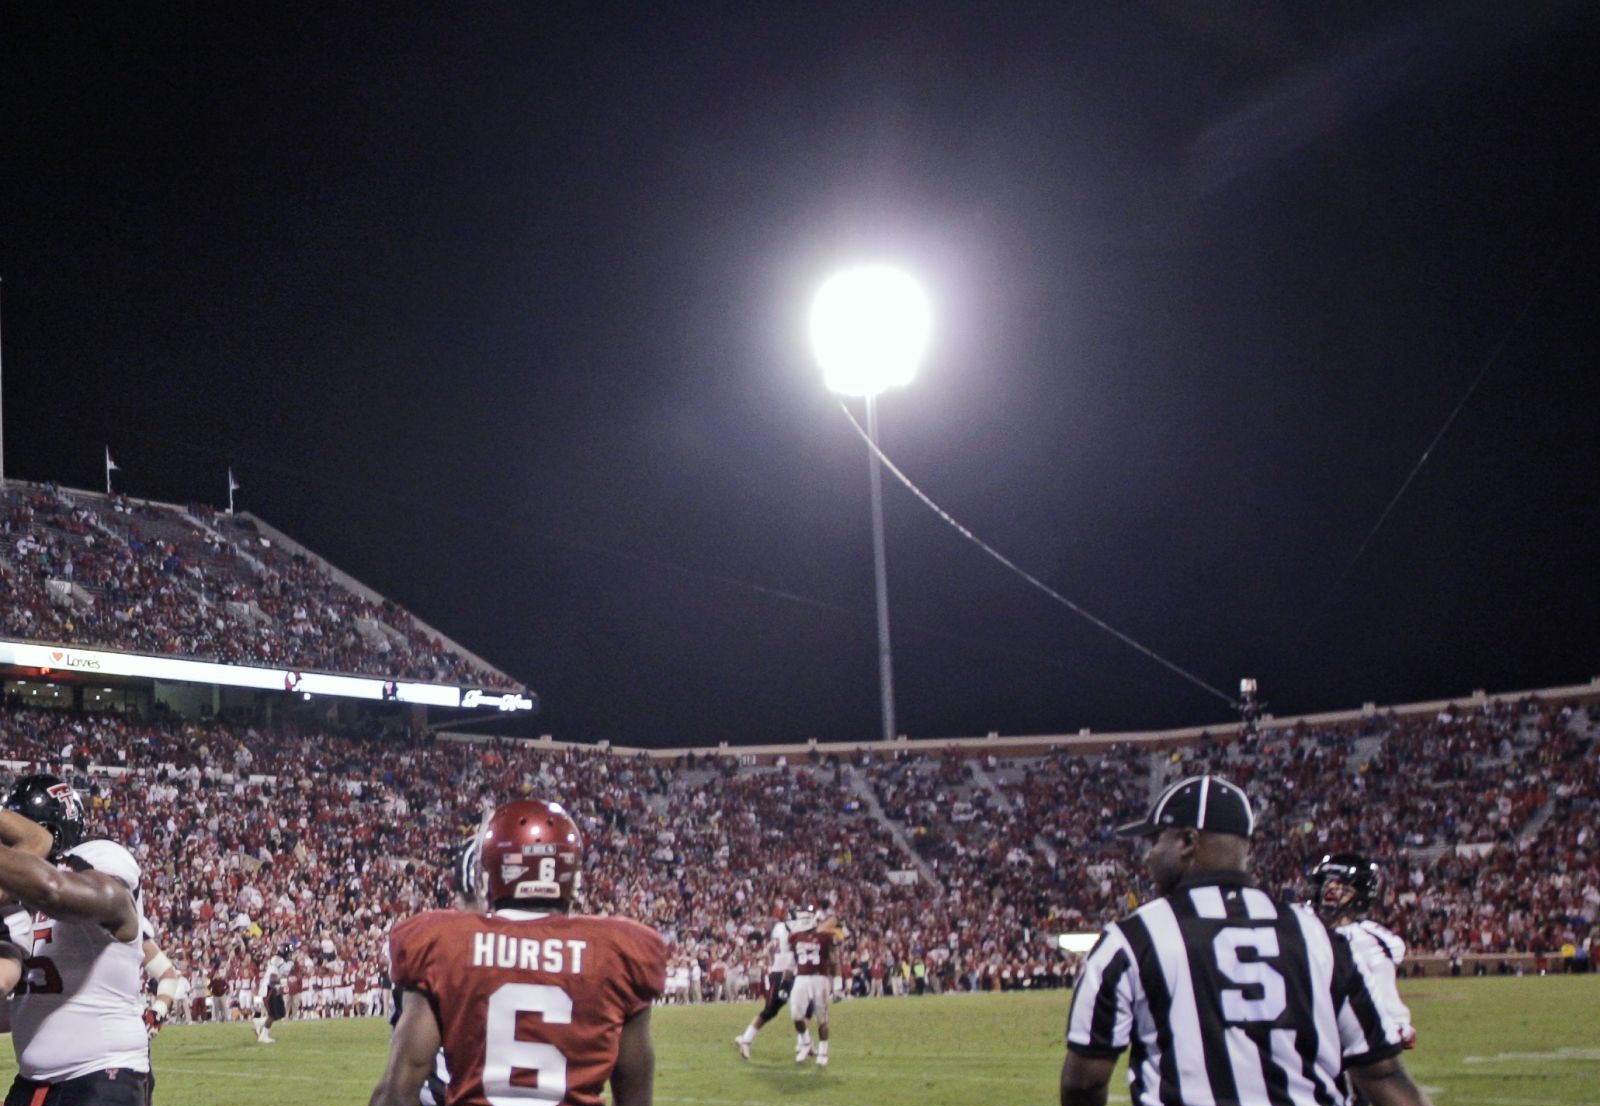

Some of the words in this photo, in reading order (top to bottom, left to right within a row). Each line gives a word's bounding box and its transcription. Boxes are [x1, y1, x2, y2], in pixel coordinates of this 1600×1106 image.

[539, 858, 556, 882] 6
[472, 932, 587, 974] HURST
[1213, 927, 1287, 1022] S
